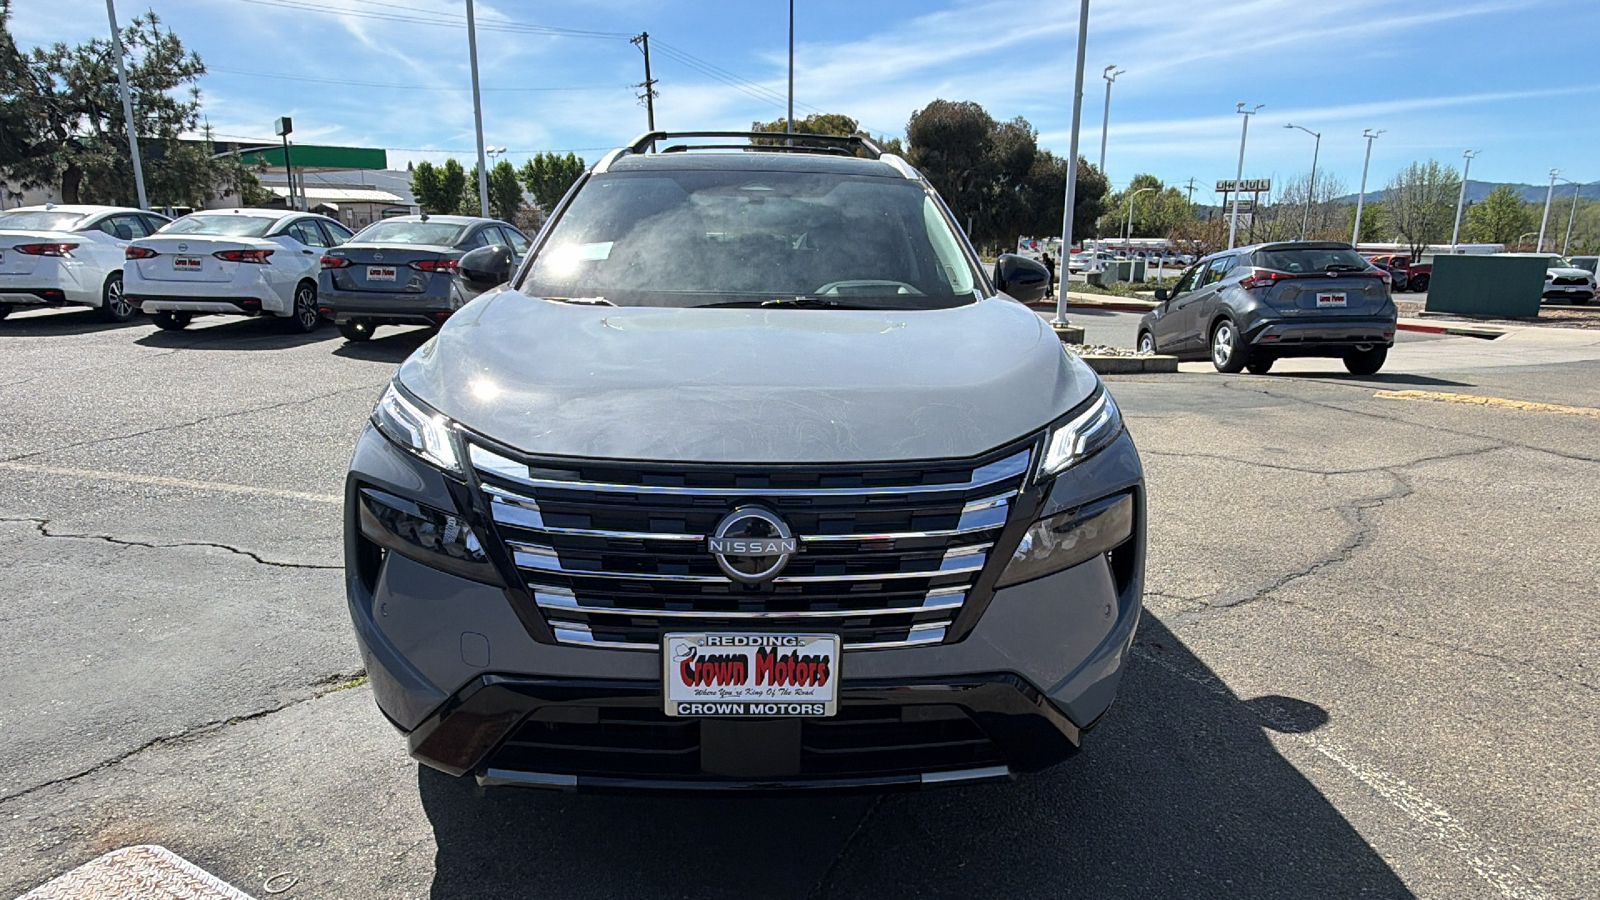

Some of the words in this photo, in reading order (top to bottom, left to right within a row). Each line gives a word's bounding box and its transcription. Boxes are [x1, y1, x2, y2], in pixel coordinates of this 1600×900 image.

[710, 540, 794, 553] NISSAN
[707, 637, 798, 646] REDDING
[680, 647, 749, 687] Crown
[755, 647, 830, 687] Motors
[745, 688, 763, 697] King
[766, 688, 775, 697] Of
[778, 688, 792, 696] The
[678, 703, 744, 715] CROWN
[749, 703, 824, 715] MOTORS
